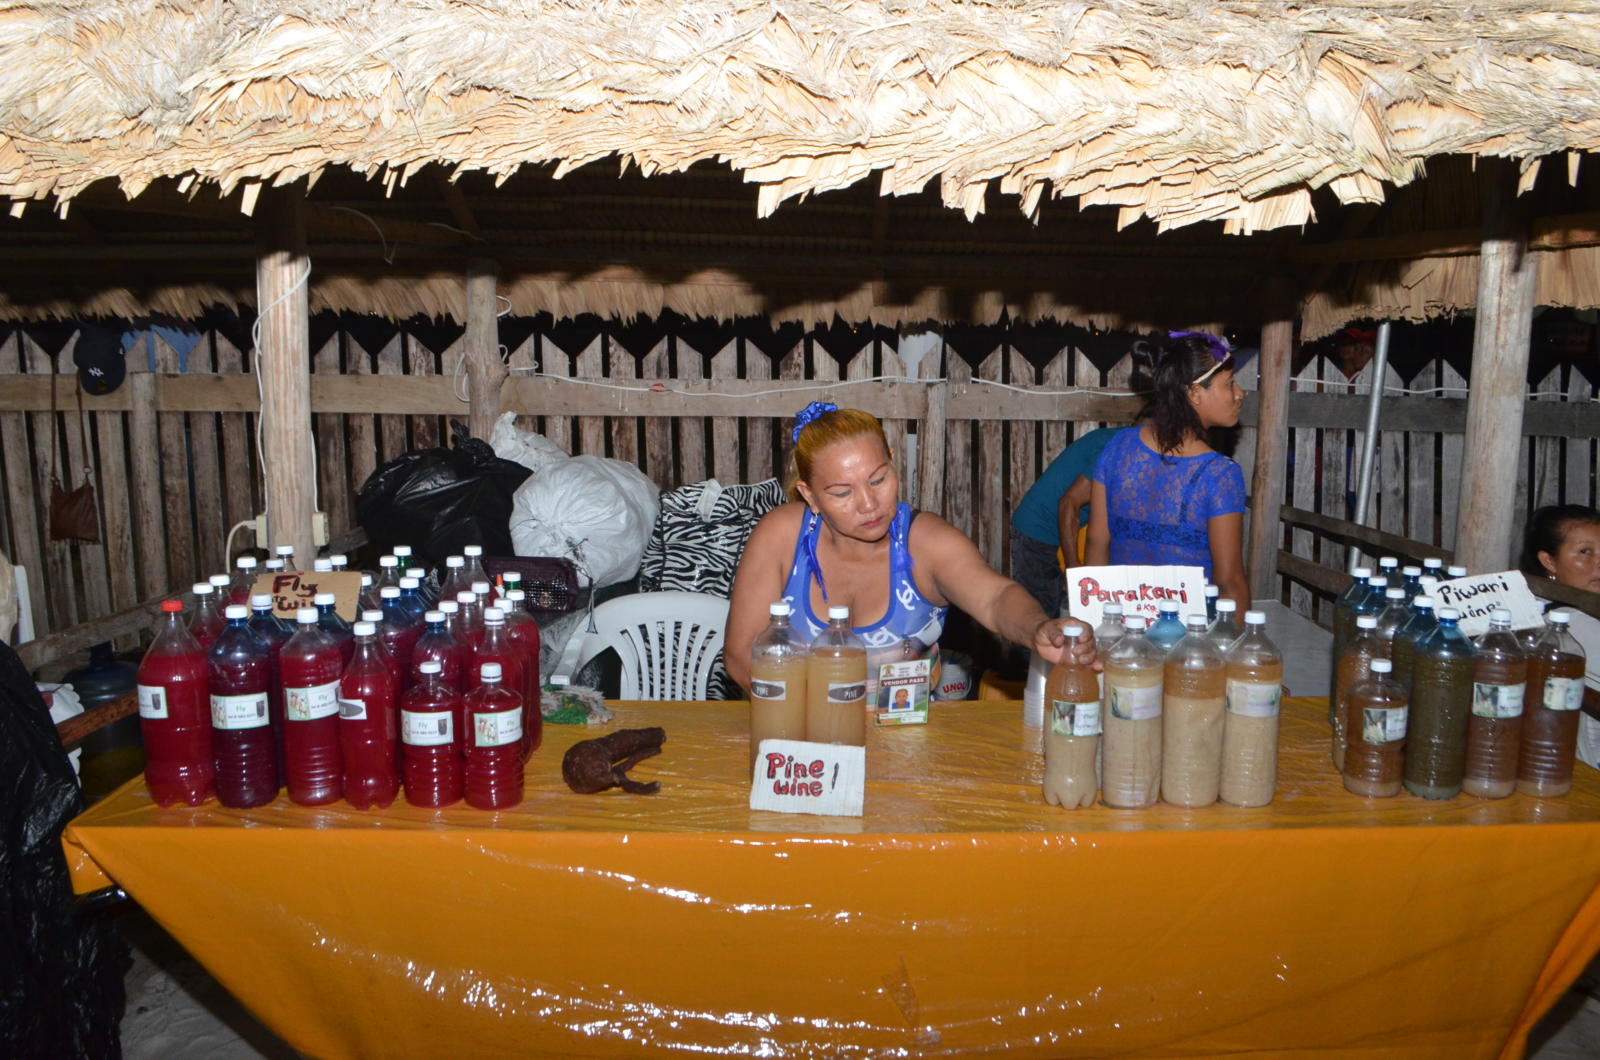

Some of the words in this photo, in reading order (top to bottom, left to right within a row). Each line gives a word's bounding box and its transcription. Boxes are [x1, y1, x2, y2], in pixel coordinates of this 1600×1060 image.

[272, 572, 319, 598] Fly
[1078, 577, 1188, 607] Parakari
[1437, 575, 1509, 605] Piwari
[883, 679, 908, 687] VENDOR
[765, 752, 825, 779] Pine
[773, 777, 825, 797] wine
